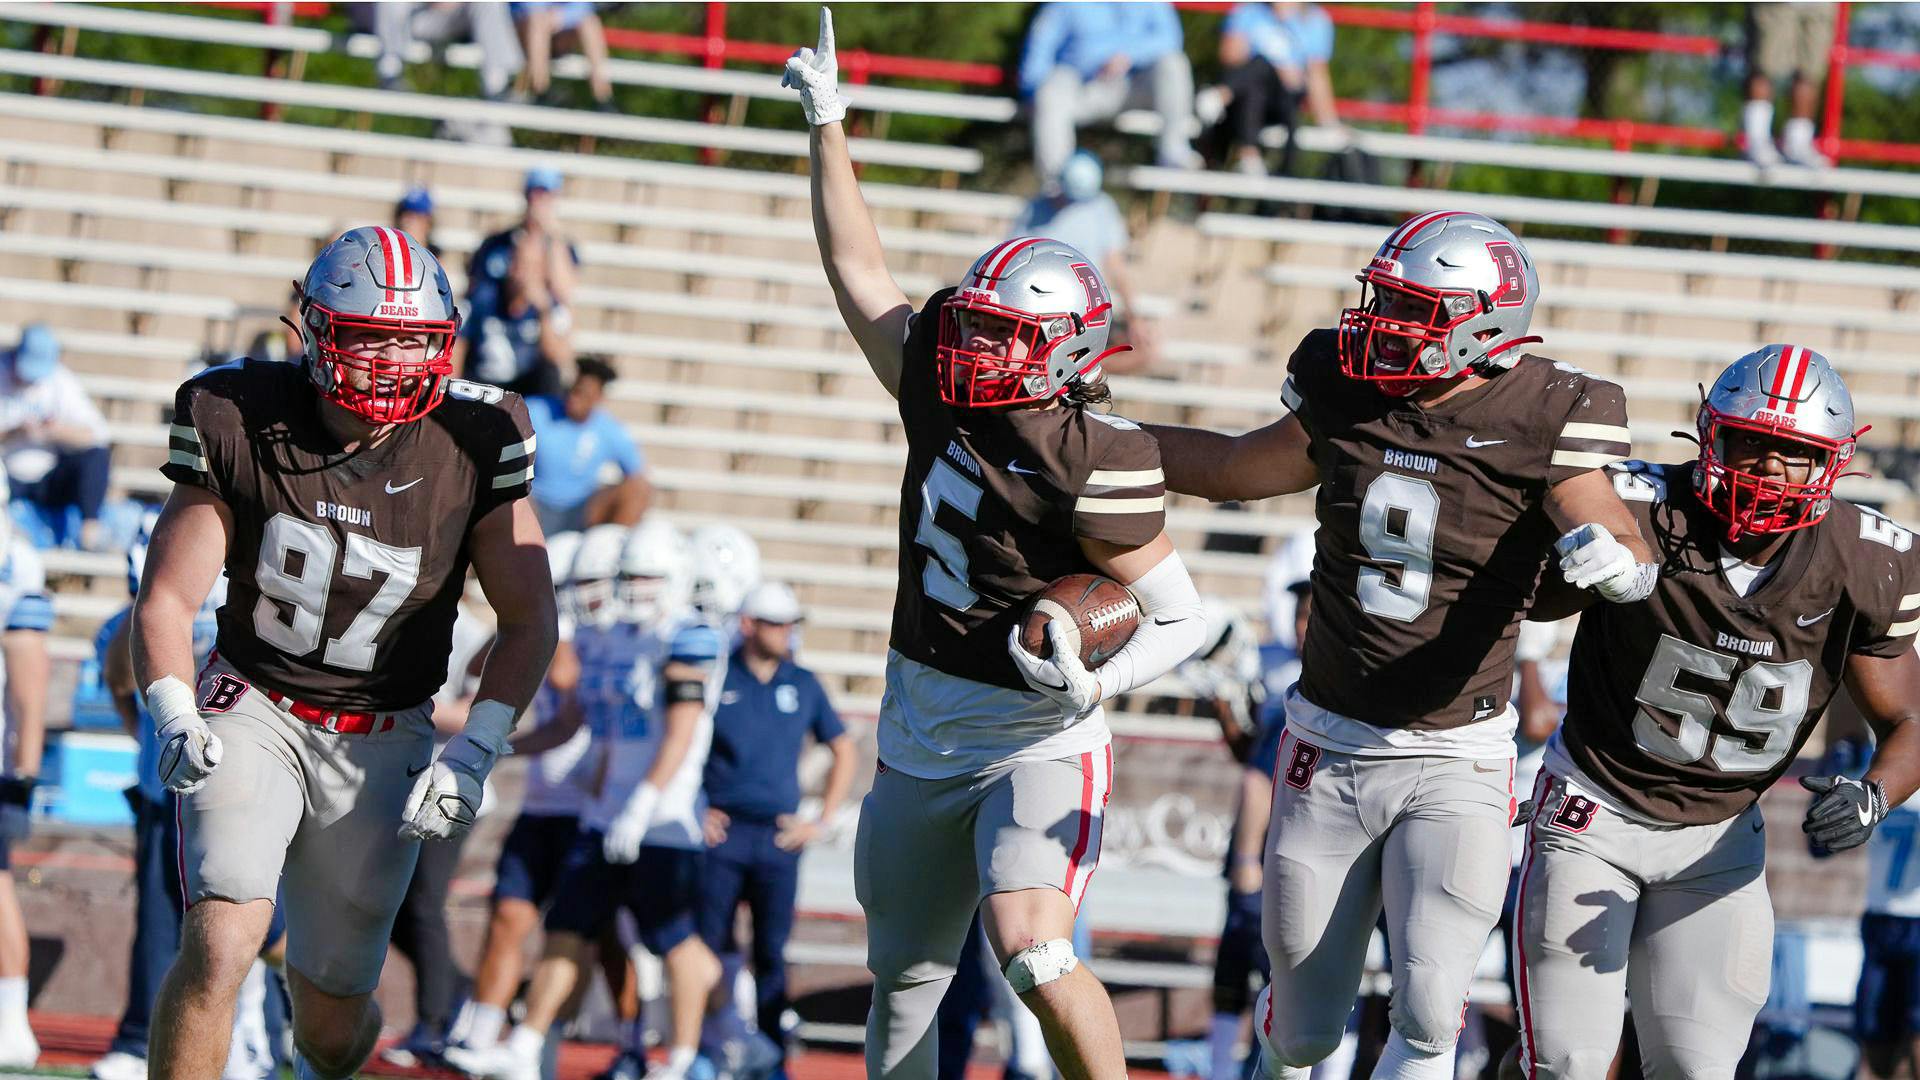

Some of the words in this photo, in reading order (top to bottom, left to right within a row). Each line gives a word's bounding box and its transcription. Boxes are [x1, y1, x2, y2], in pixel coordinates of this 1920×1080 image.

[1485, 241, 1527, 307] B
[380, 304, 419, 317] BEARS
[1755, 411, 1798, 428] BEARS
[946, 439, 982, 478] BROWN
[1384, 448, 1438, 474] BROWN
[315, 500, 371, 527] BROWN
[914, 456, 984, 613] 5
[1356, 471, 1440, 623] 9
[252, 511, 422, 673] 97
[1716, 631, 1774, 657] BROWN
[200, 672, 250, 713] B
[1483, 698, 1490, 708] L
[1631, 633, 1813, 772] 59
[1285, 738, 1322, 792] B
[1550, 794, 1600, 834] B
